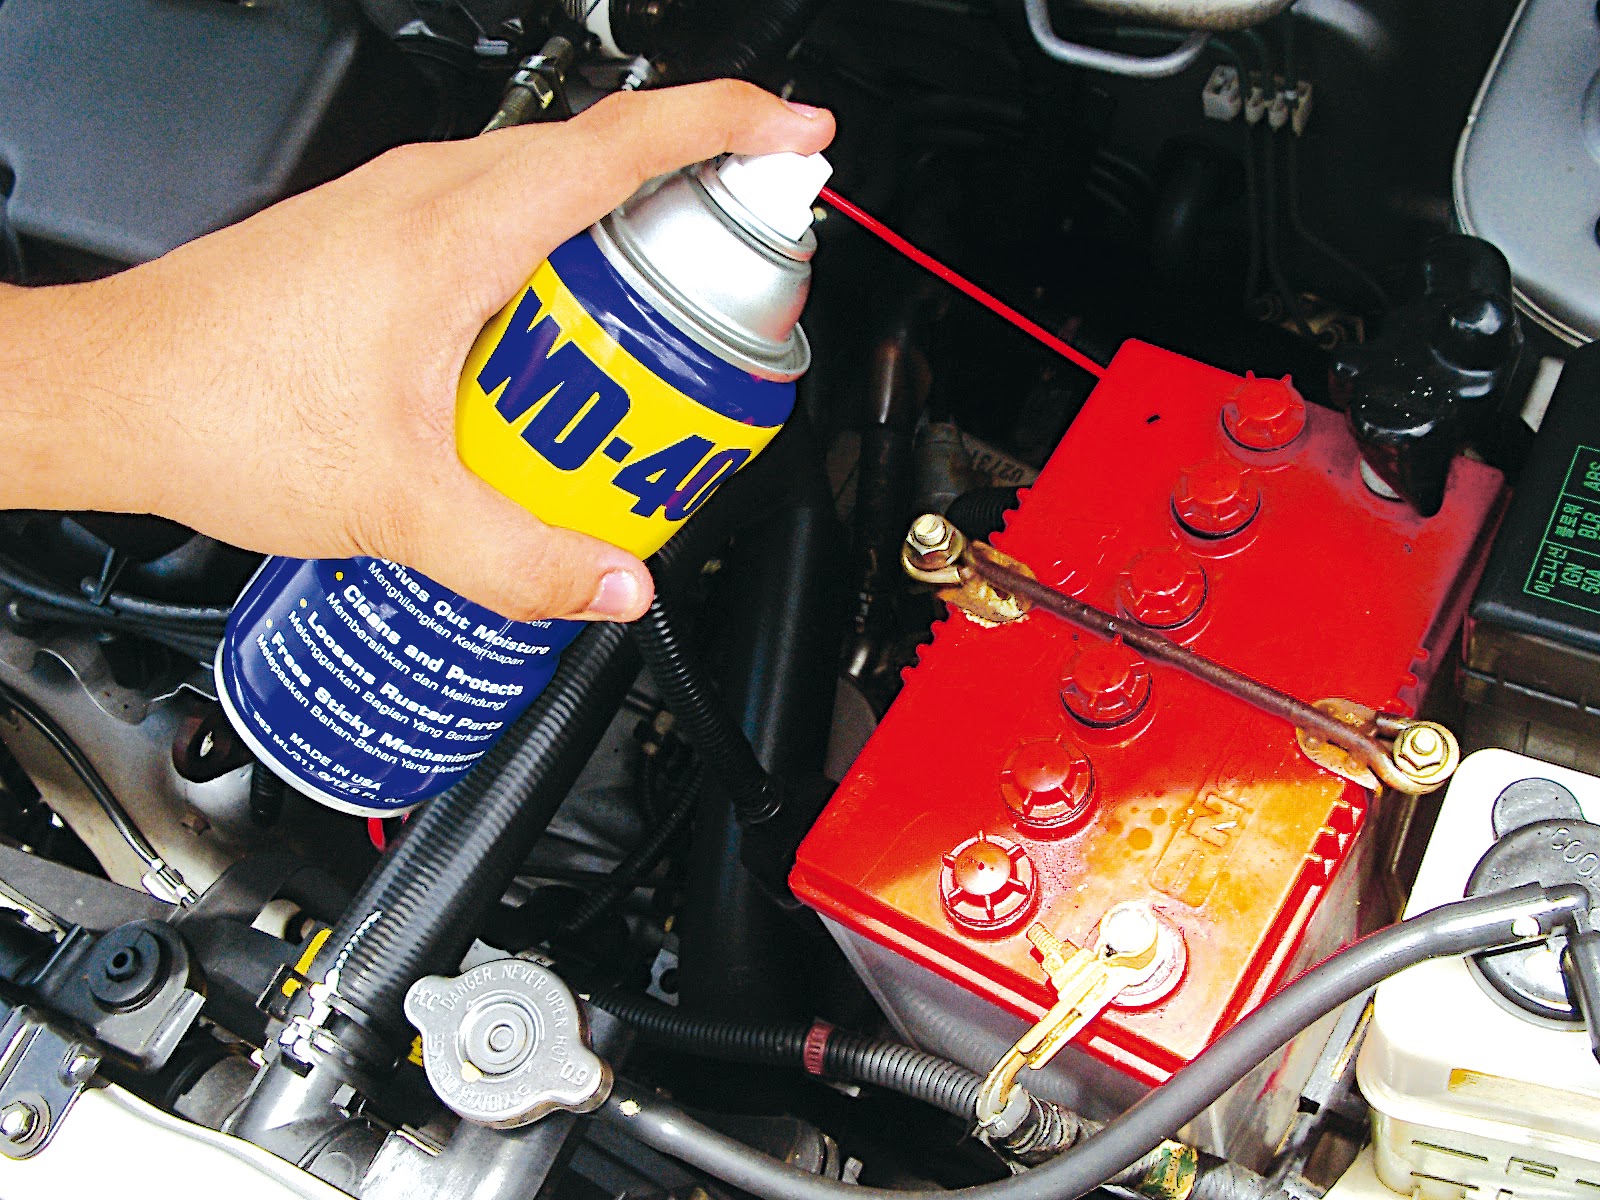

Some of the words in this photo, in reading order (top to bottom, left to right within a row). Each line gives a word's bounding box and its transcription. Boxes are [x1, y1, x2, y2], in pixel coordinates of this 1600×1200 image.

[477, 286, 752, 520] WD-40
[368, 562, 451, 639] Menghilangkan
[381, 558, 430, 603] rives
[433, 599, 471, 630] Out
[472, 624, 551, 655] Moisture
[1560, 562, 1585, 587] IGN
[271, 631, 312, 687] Frees
[314, 686, 376, 737] Sticky
[288, 610, 360, 694] Melonggarkan
[362, 691, 409, 724] Bagian
[413, 718, 443, 738] Yang
[307, 610, 376, 685] Loosens
[380, 682, 454, 725] Rusted
[455, 718, 504, 731] Parts
[326, 592, 410, 675] Membersihkan
[412, 672, 439, 691] dan
[441, 685, 508, 711] Melindungi
[343, 585, 401, 645] Cleans
[403, 644, 444, 673] and
[446, 665, 523, 696] Protects
[256, 633, 310, 707] Melepaskan
[310, 705, 398, 764] Bahan-Bahan
[401, 758, 430, 773] Yang
[290, 732, 332, 767] MADE
[332, 763, 350, 777] IN
[351, 774, 382, 791] USA
[502, 964, 548, 991] NEVER
[545, 989, 569, 1029] OPEN
